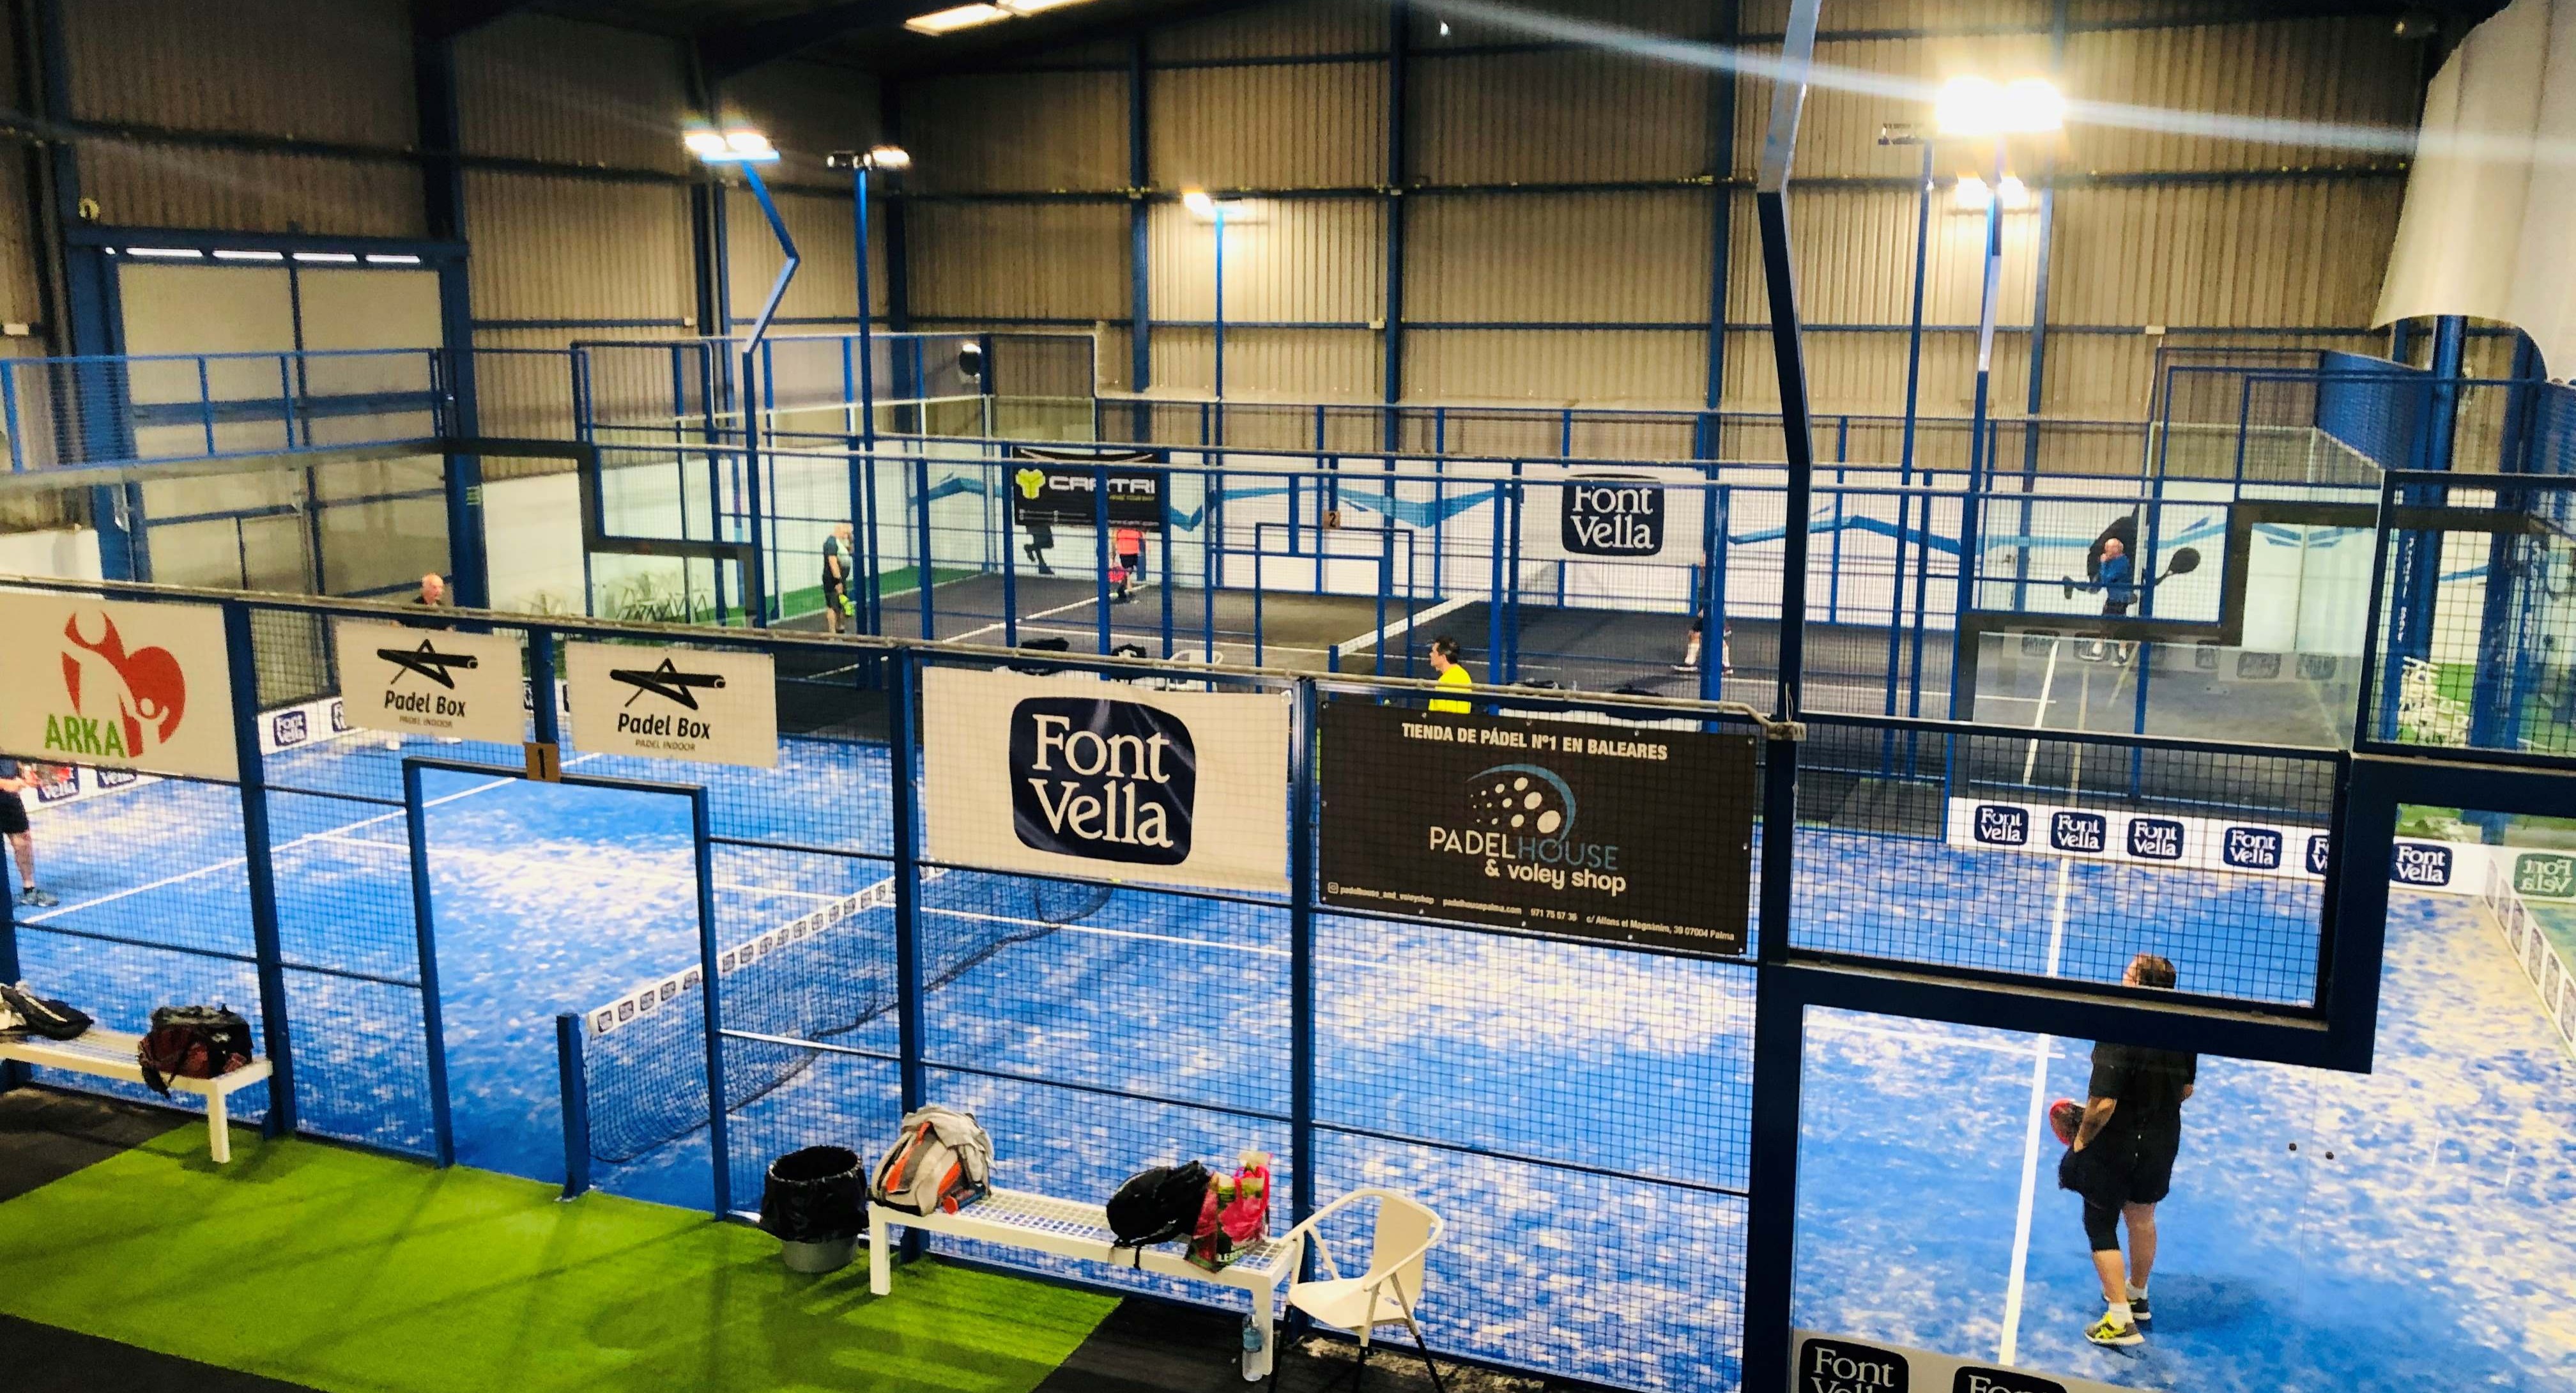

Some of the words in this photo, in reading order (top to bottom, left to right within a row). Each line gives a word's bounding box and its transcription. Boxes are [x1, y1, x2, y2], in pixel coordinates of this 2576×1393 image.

[1572, 486, 1653, 514] Font
[1329, 512, 1336, 527] 2
[1570, 514, 1654, 549] Vella
[384, 690, 430, 713] Padel
[436, 696, 466, 717] Box
[45, 713, 125, 758] ARKA
[617, 712, 671, 735] Padel
[677, 718, 711, 739] Box
[635, 739, 660, 749] PADEL
[663, 741, 696, 751] INDOOR
[1032, 713, 1172, 784] Font
[1402, 723, 1454, 742] TIENDA
[1457, 728, 1476, 744] DE
[1480, 726, 1527, 748] PÁDEL
[1563, 737, 1582, 753] EN
[1587, 738, 1668, 760] BALEARES
[537, 748, 546, 778] 1
[1028, 778, 1174, 849] Vella
[1981, 808, 2023, 827] Font
[2058, 815, 2100, 834] Font
[1980, 824, 2023, 842] Vella
[2057, 831, 2100, 849] Vella
[2134, 820, 2177, 841] Font
[2230, 830, 2276, 850] Font
[1429, 826, 1618, 870] PADELHOUSE
[2133, 838, 2176, 856] Vella
[2229, 847, 2274, 866] Vella
[2396, 845, 2445, 866] Font
[1484, 858, 1499, 877] &
[1508, 861, 1565, 889] voley
[1572, 868, 1626, 896] shop
[2395, 862, 2444, 884] Vella
[1685, 927, 1708, 937] 07004
[1710, 930, 1735, 941] Palma
[1812, 1346, 1894, 1388] Font
